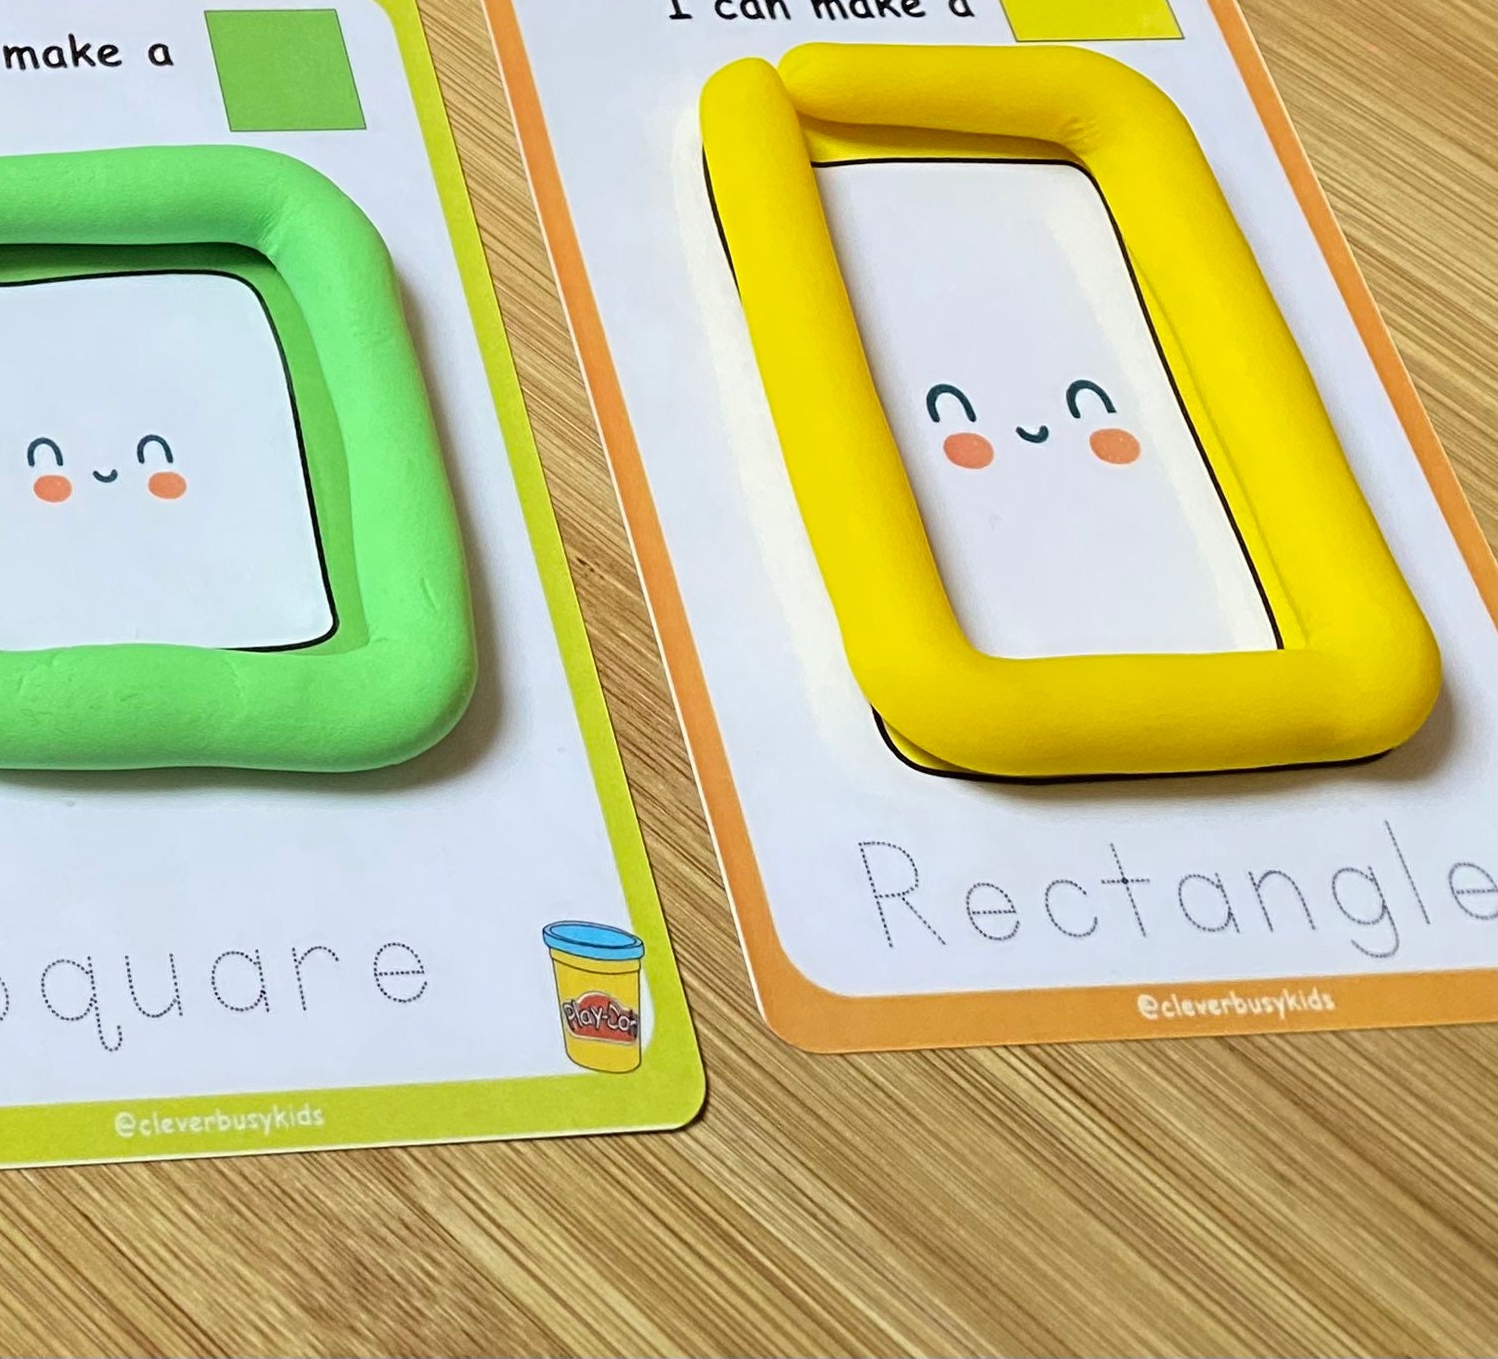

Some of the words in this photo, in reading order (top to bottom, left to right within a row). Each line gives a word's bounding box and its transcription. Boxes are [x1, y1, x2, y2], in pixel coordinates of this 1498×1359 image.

[2, 32, 123, 71] make
[147, 42, 175, 67] a
[857, 818, 1498, 961] Rectangle
[1136, 988, 1337, 1021] @cleverbusykids
[113, 1101, 327, 1139] @cleverbusykids
